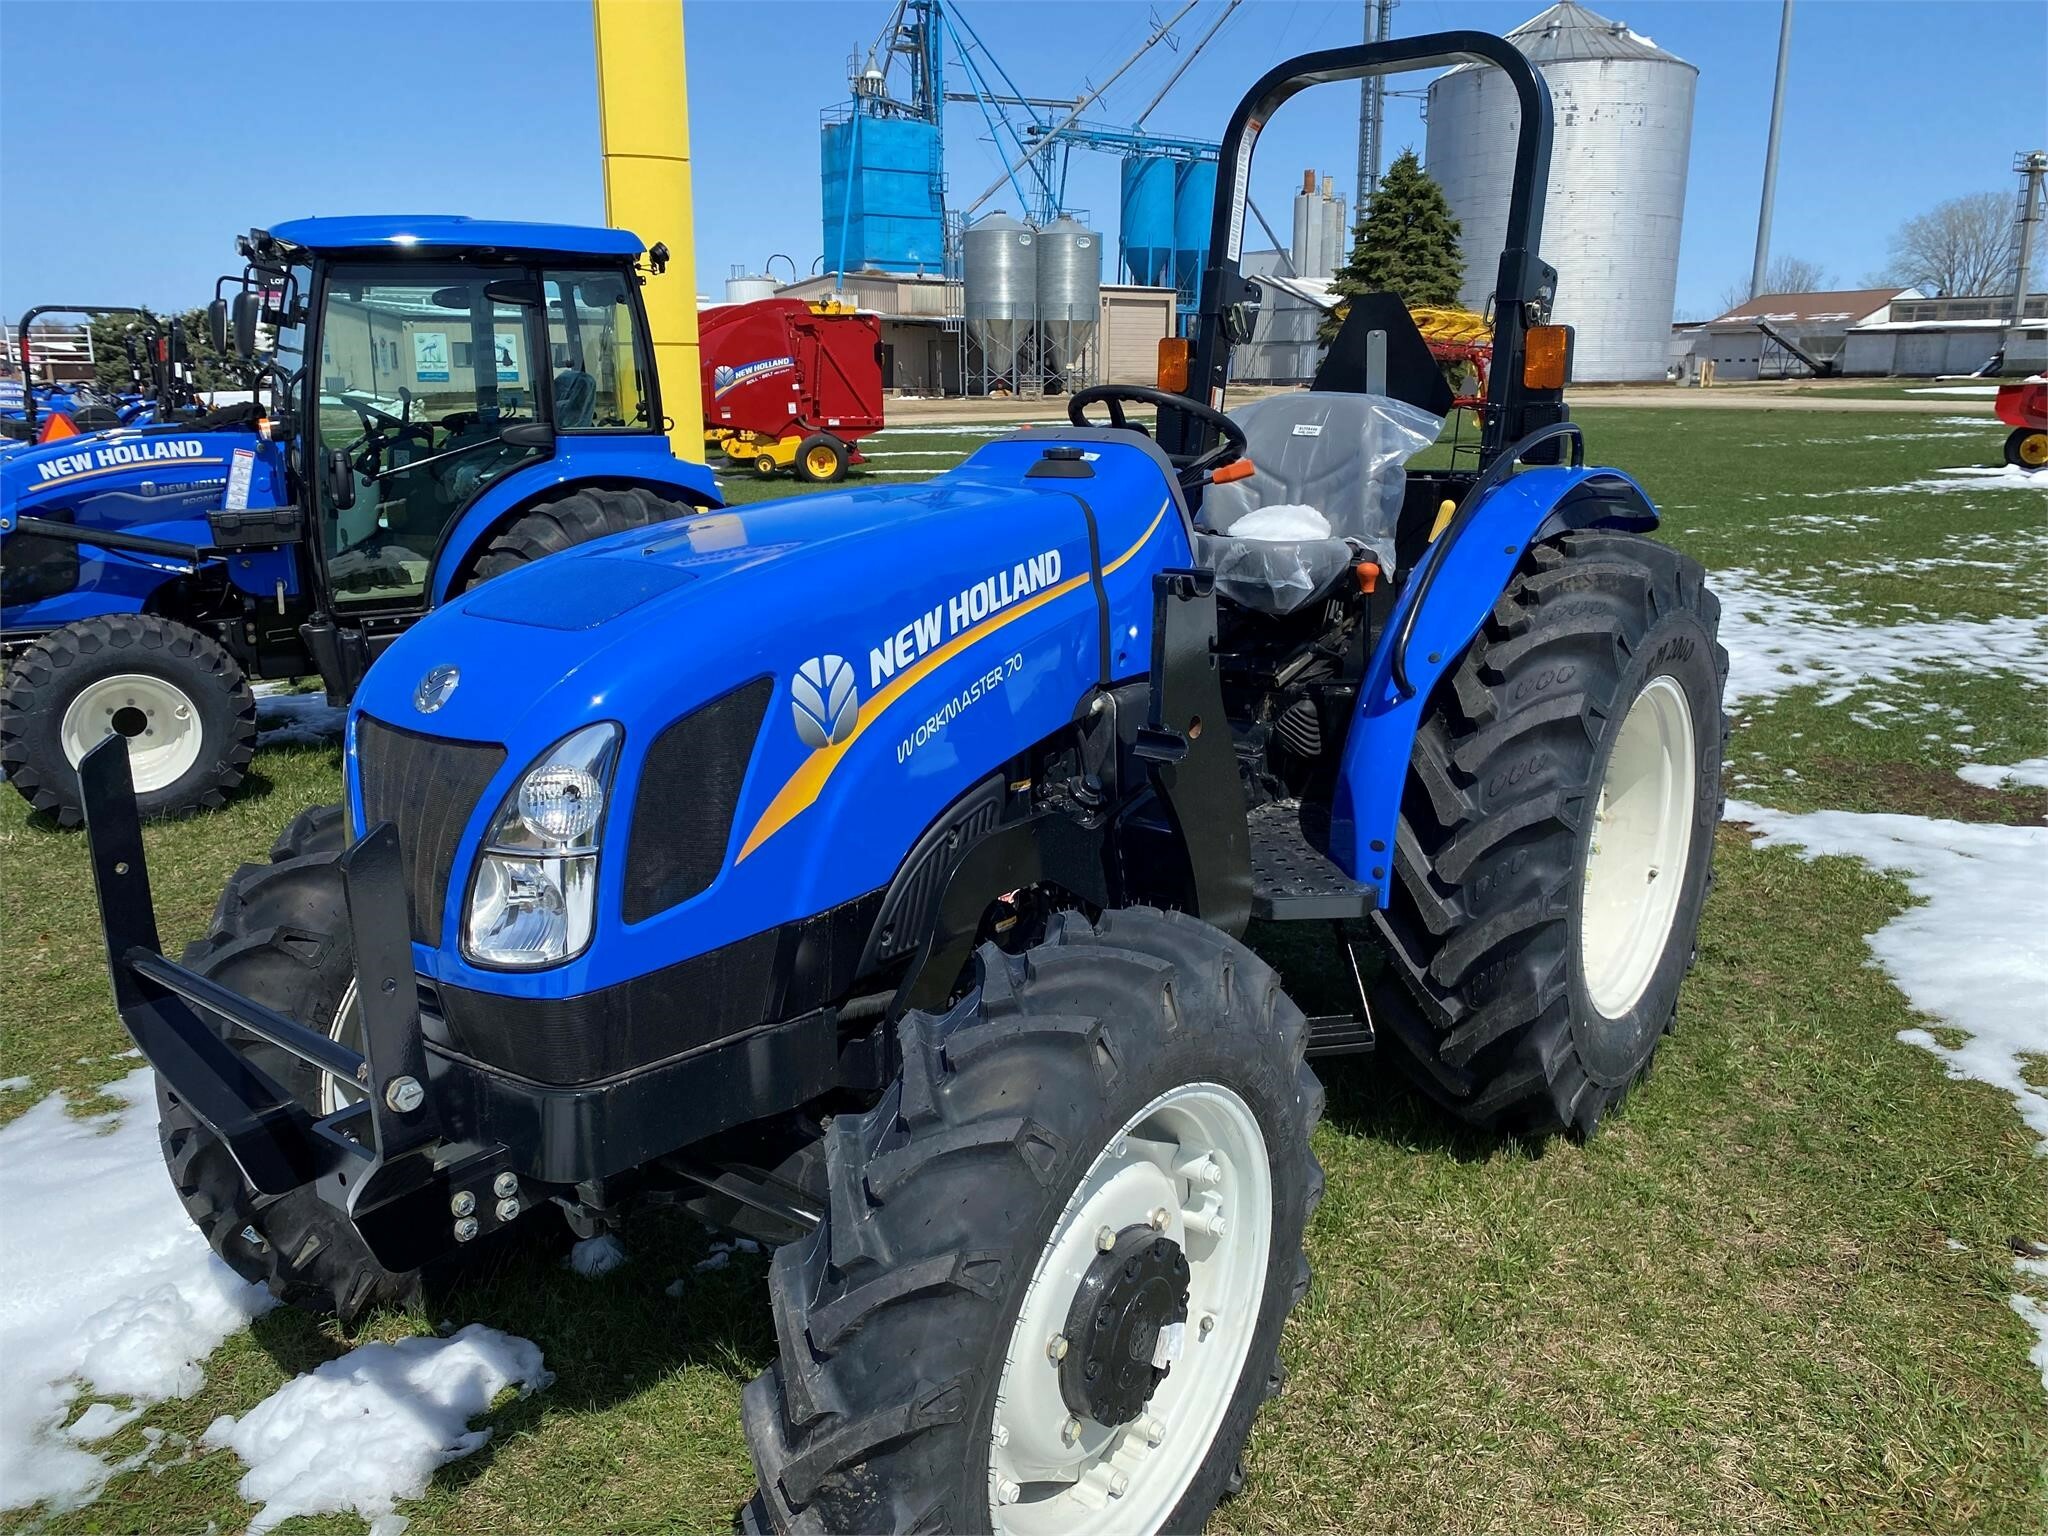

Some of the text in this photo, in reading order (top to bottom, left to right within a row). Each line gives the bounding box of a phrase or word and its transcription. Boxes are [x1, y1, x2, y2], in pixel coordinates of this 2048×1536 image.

[735, 365, 753, 379] NEW
[754, 357, 790, 372] HOLLAND
[37, 440, 203, 480] NEW HOLLAND
[159, 477, 227, 495] NEW HOLLA
[869, 549, 1062, 689] NEW HOLLAND
[1666, 636, 1695, 662] 2000
[896, 653, 1023, 764] WORKMASTER 70
